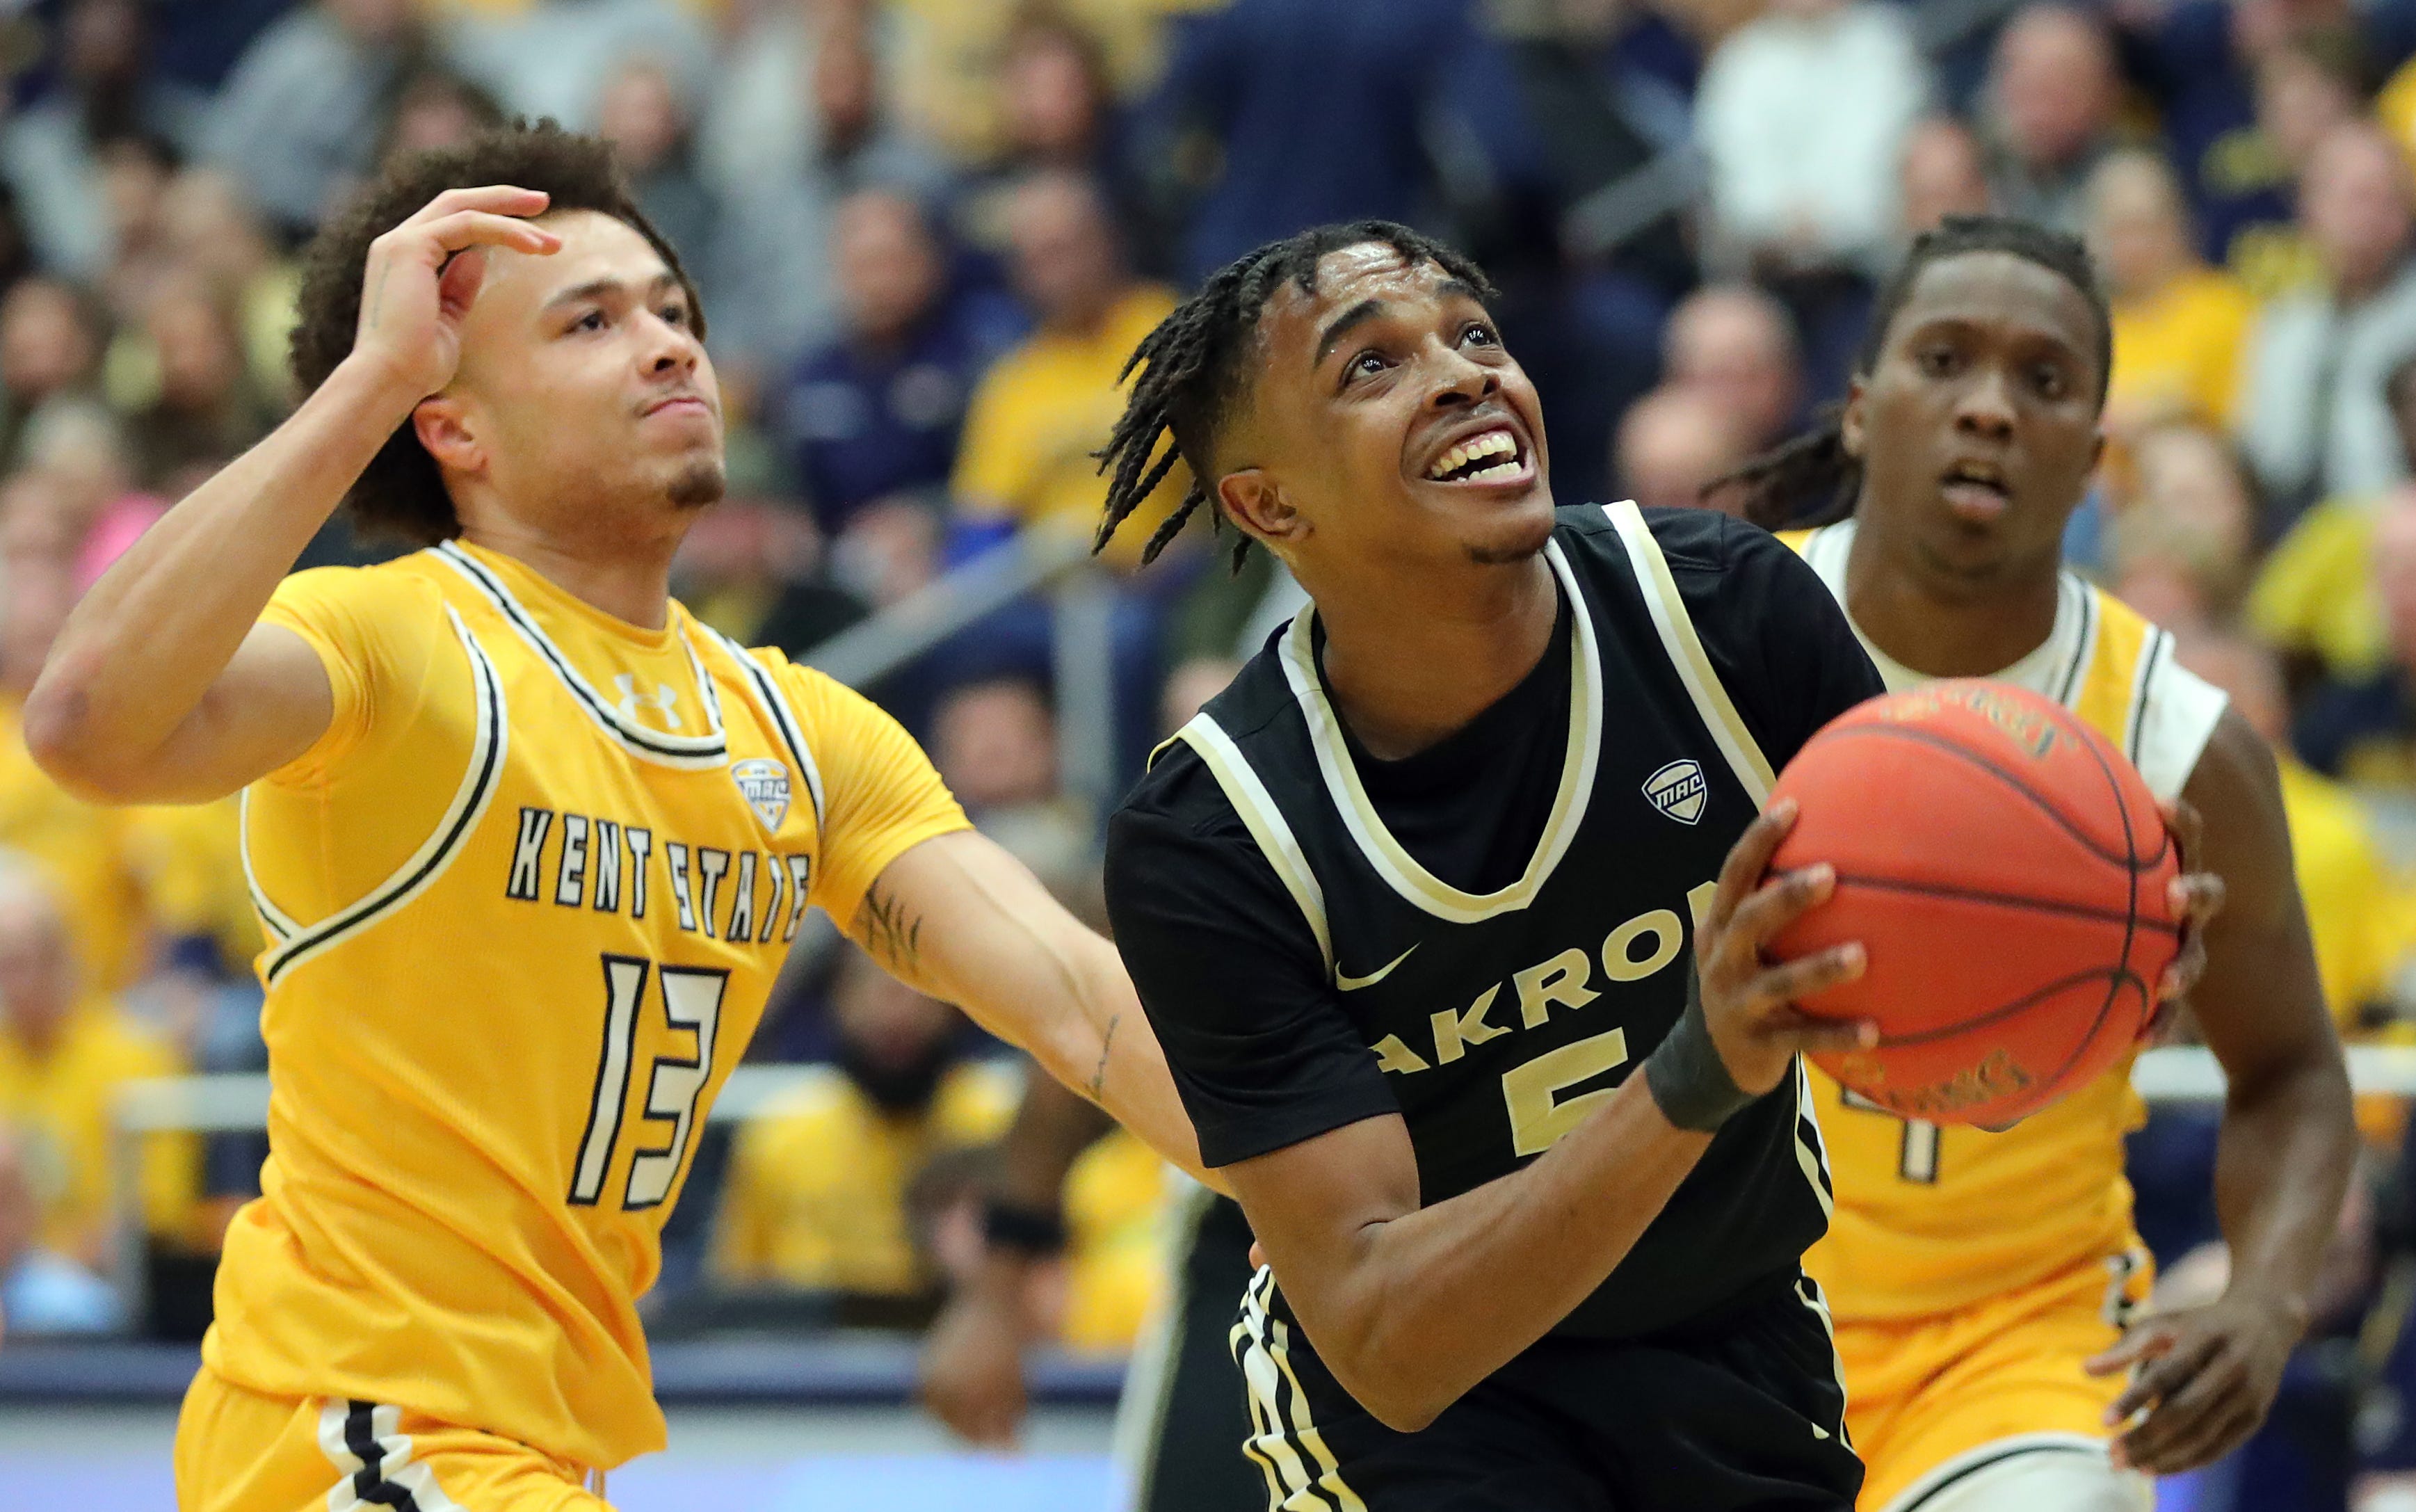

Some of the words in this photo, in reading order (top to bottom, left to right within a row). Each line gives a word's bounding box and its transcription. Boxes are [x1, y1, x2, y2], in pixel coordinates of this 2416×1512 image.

[506, 807, 651, 919] KENT
[1655, 774, 1705, 809] MAC
[1368, 880, 1718, 1075] AKRO
[567, 953, 732, 1211] 13
